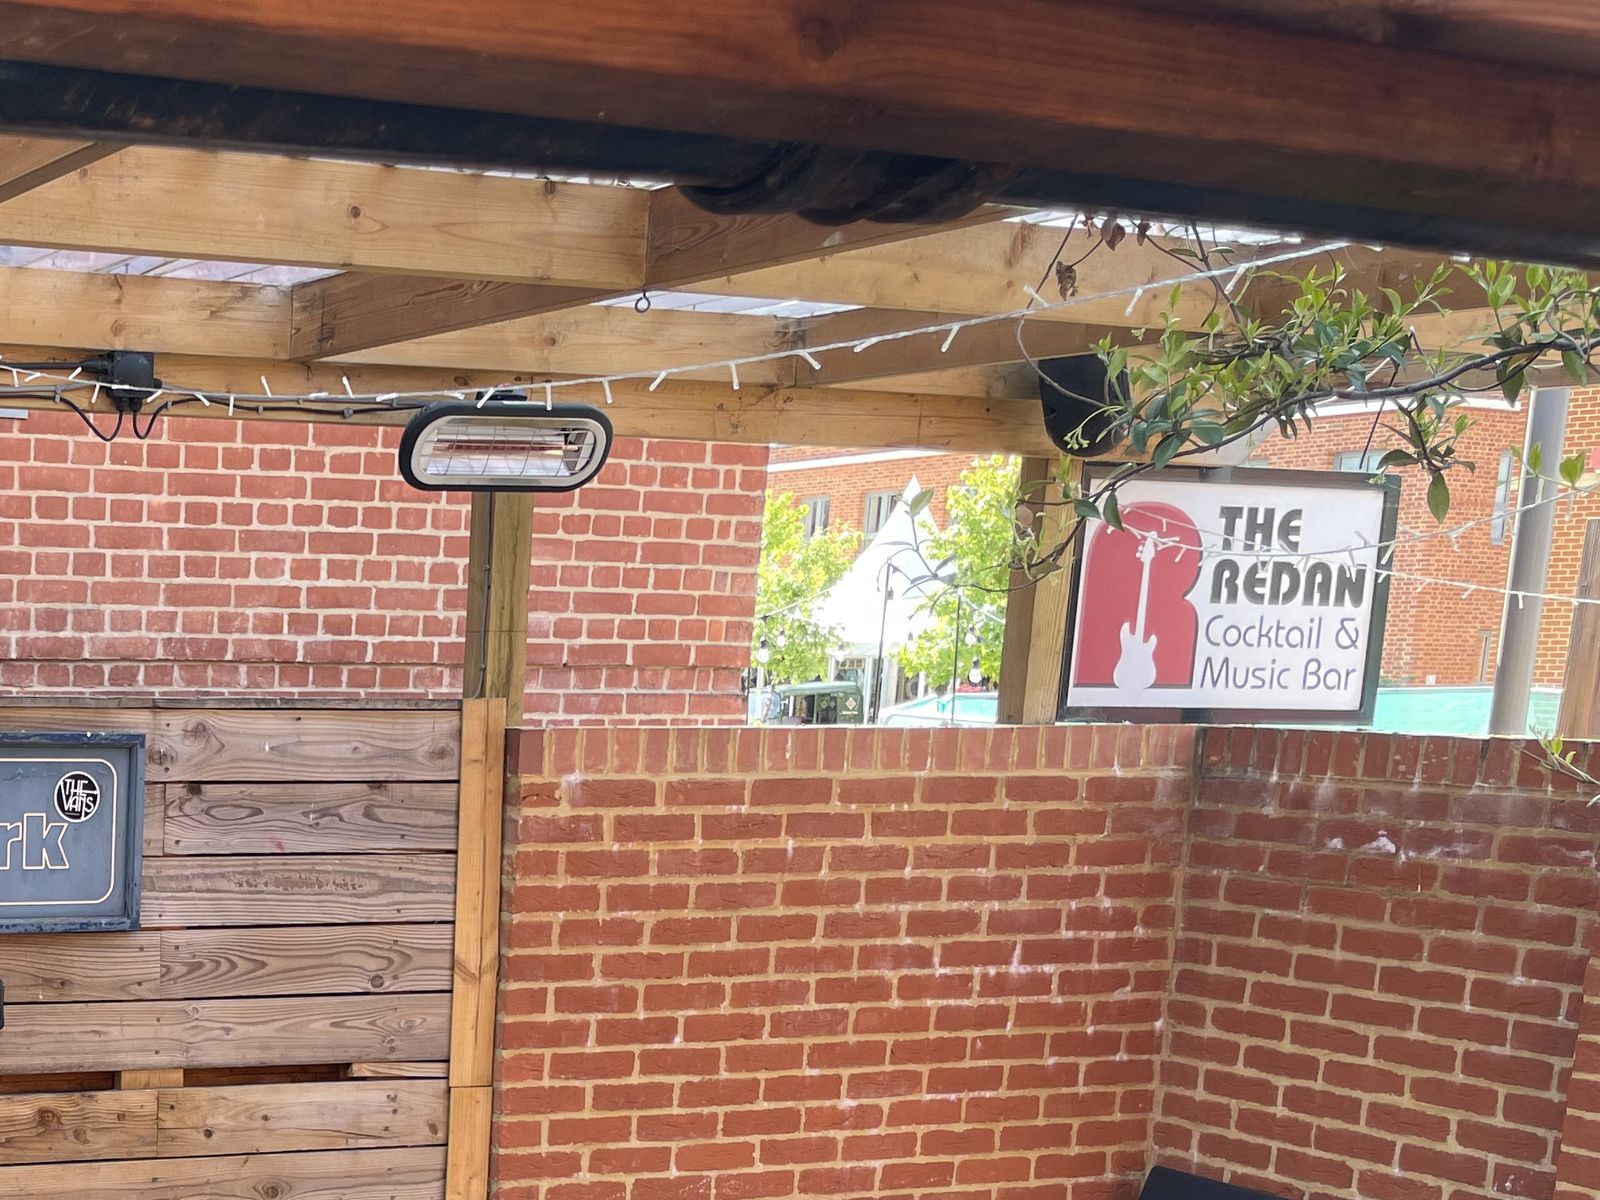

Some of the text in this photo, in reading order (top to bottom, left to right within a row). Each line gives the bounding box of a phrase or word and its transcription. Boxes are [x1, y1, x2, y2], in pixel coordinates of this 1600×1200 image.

[1219, 506, 1303, 553] THE
[1210, 559, 1366, 608] REDAN
[1204, 614, 1361, 650] Cocktail &
[1199, 656, 1357, 691] Music Bar
